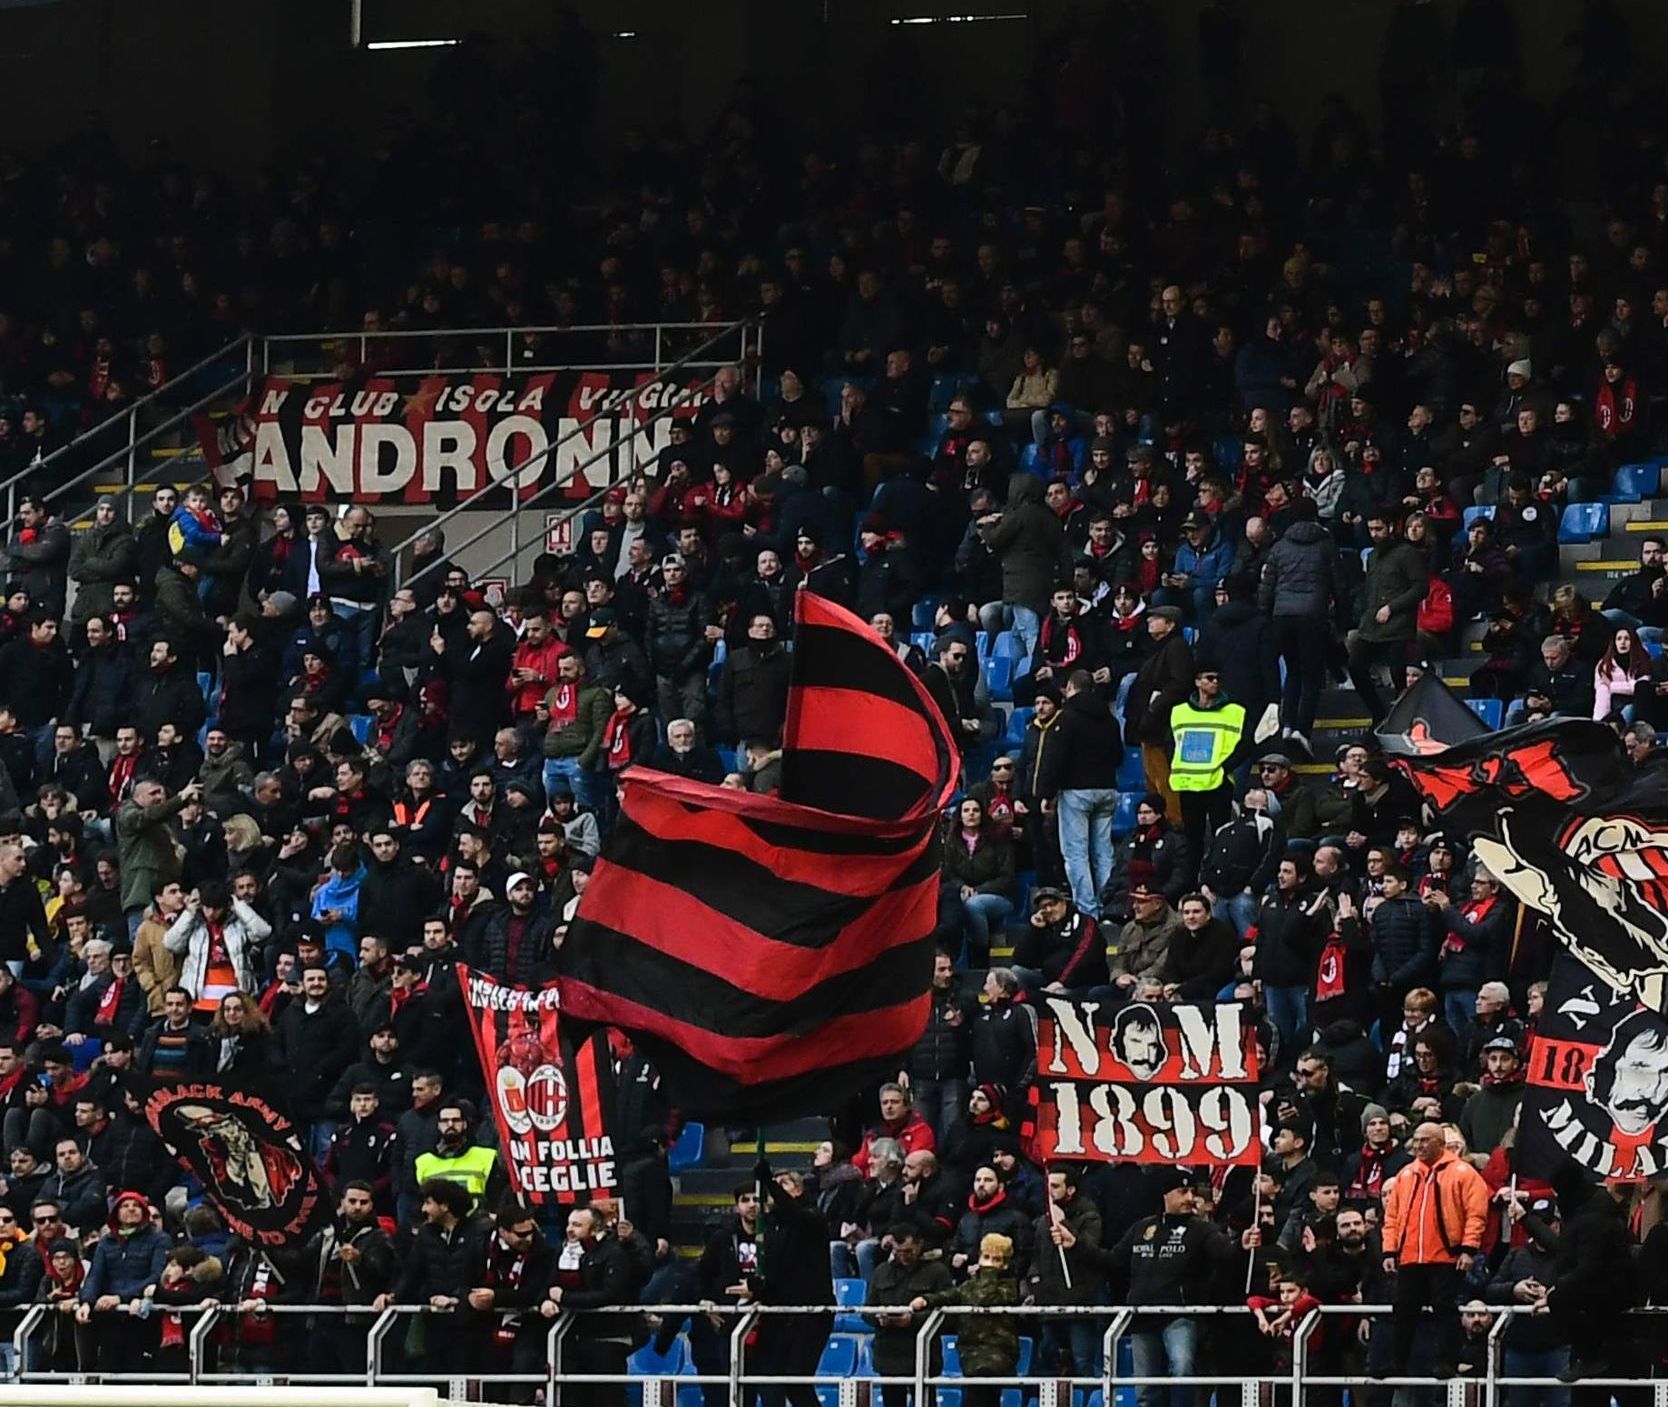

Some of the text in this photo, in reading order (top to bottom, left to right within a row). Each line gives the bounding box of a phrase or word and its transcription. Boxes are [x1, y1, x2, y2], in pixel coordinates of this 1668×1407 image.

[303, 386, 399, 418] CLUB
[435, 384, 544, 412] ISOLA
[1576, 825, 1653, 862] ACM
[1050, 1083, 1252, 1161] 1899
[538, 1135, 615, 1161] FOLLIA
